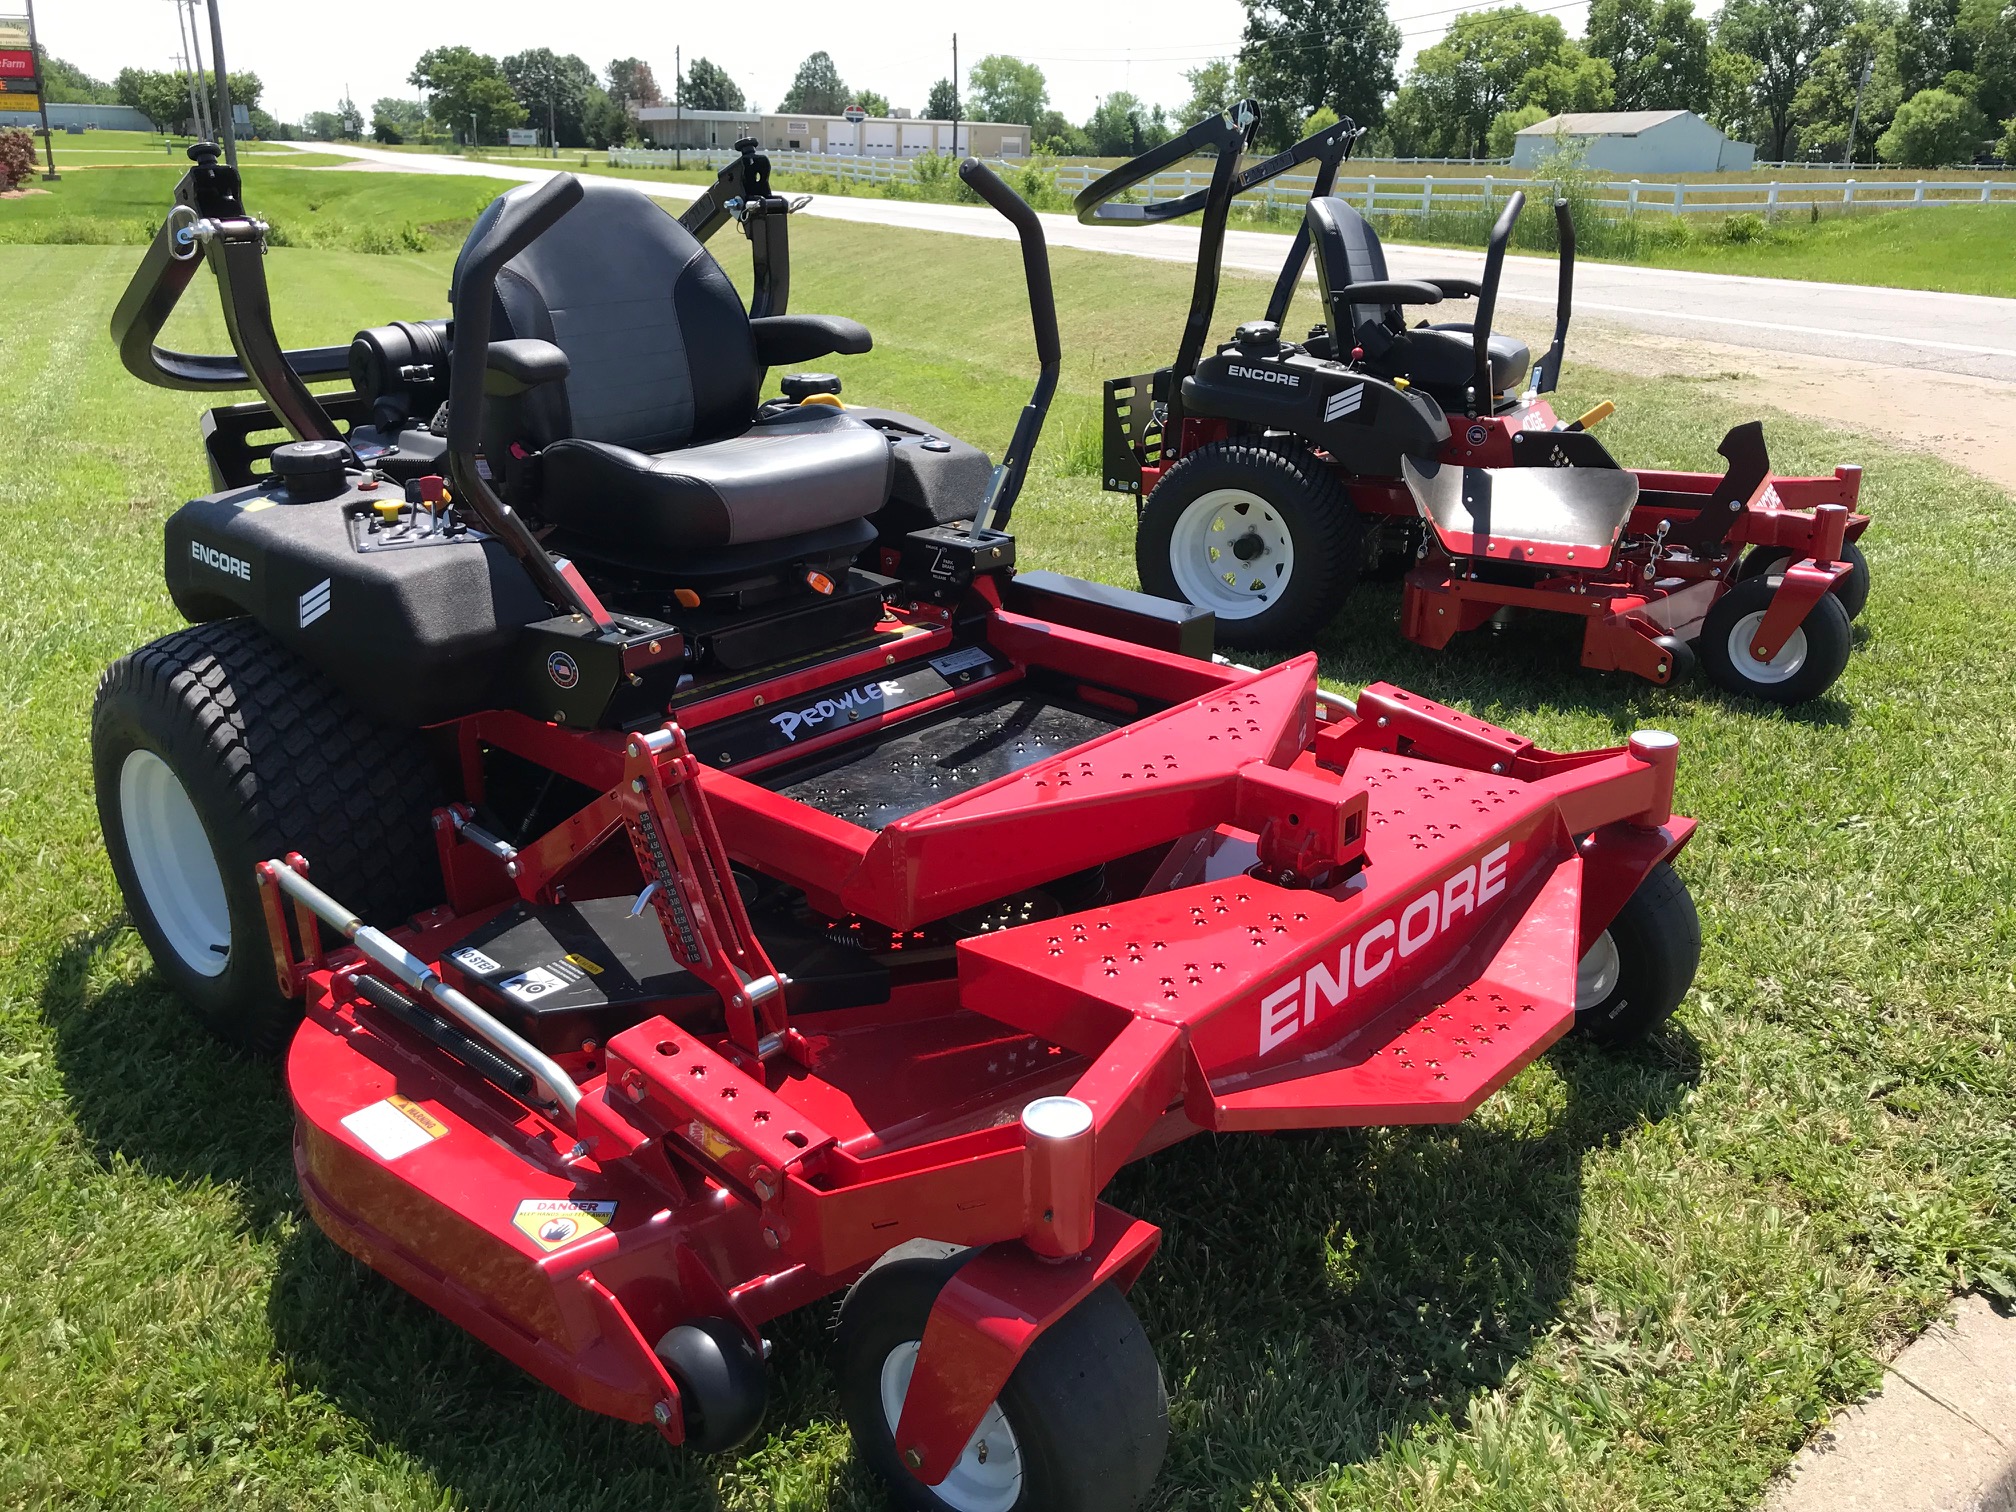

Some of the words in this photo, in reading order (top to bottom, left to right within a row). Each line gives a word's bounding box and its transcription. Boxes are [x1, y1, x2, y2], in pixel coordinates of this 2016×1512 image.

[1228, 364, 1300, 387] ENCORE
[191, 540, 251, 581] ENCORE
[459, 948, 473, 959] NO
[469, 953, 495, 971] STEP
[691, 954, 700, 962] 1.50
[1259, 840, 1510, 1057] ENCORE
[406, 1107, 436, 1129] WARNING
[537, 1202, 599, 1211] DANGER
